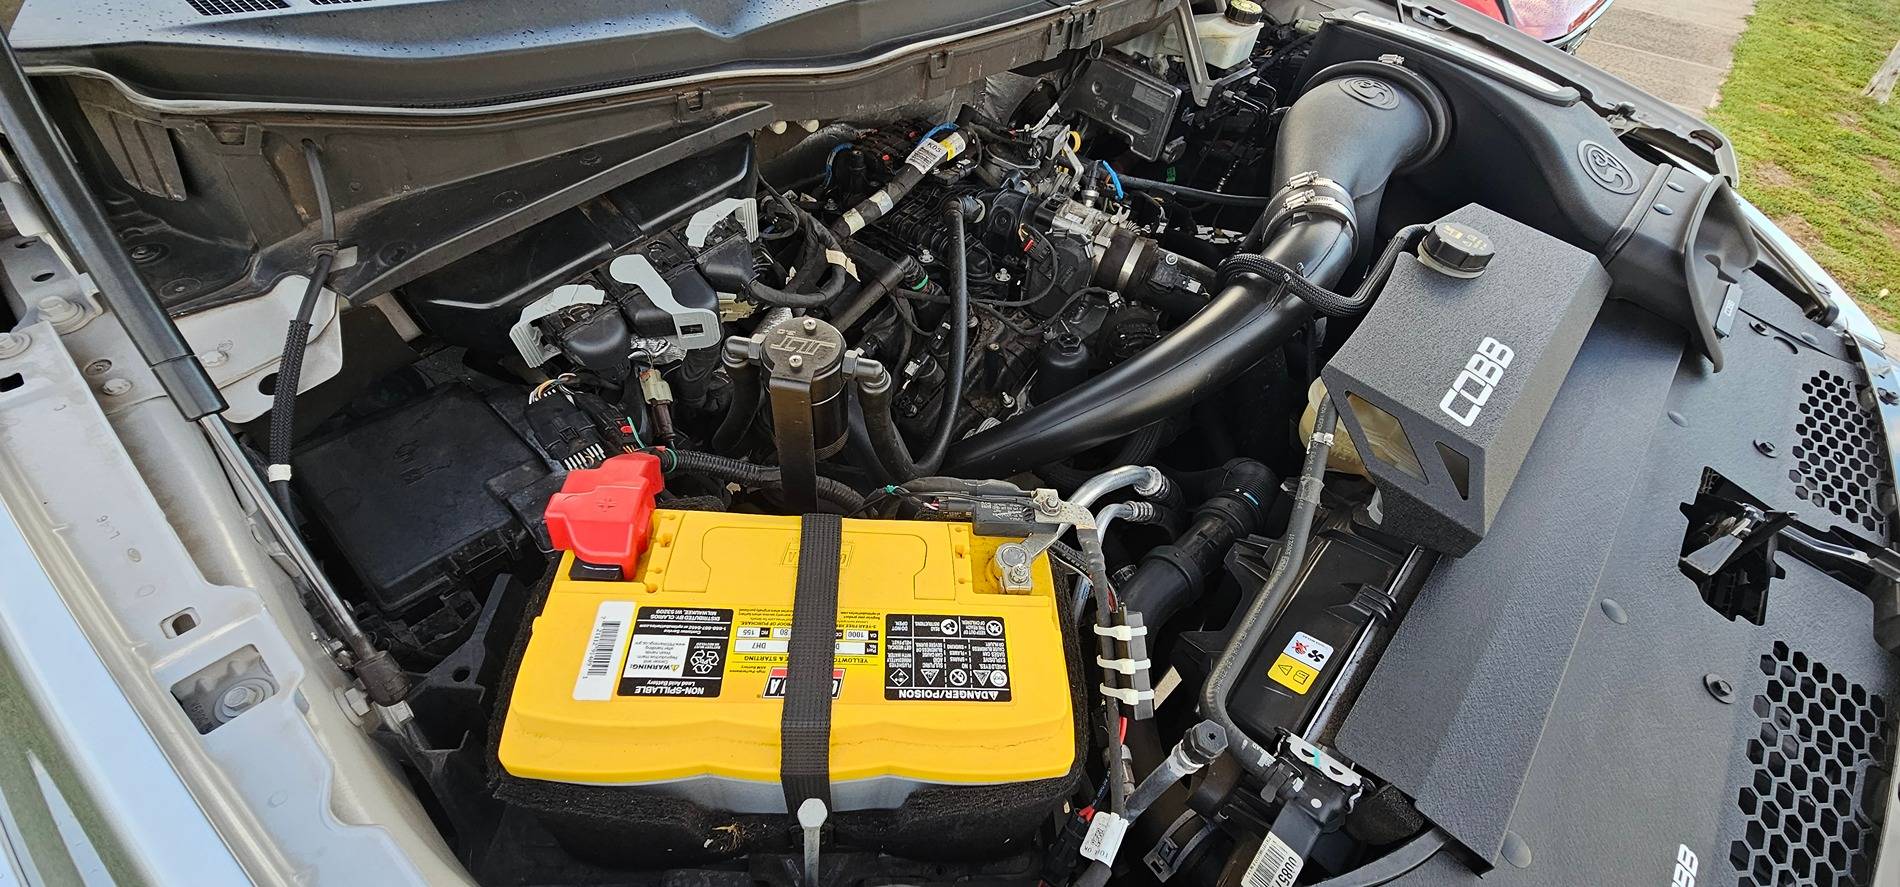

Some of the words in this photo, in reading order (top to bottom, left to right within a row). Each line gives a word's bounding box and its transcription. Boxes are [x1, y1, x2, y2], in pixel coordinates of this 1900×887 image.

[1724, 300, 1735, 316] COBB
[770, 334, 836, 355] JLT
[1440, 336, 1515, 426] COBB
[634, 686, 704, 695] NON-SPILLABLE
[899, 690, 988, 700] DANGER/POISON
[1672, 844, 1699, 887] BB
